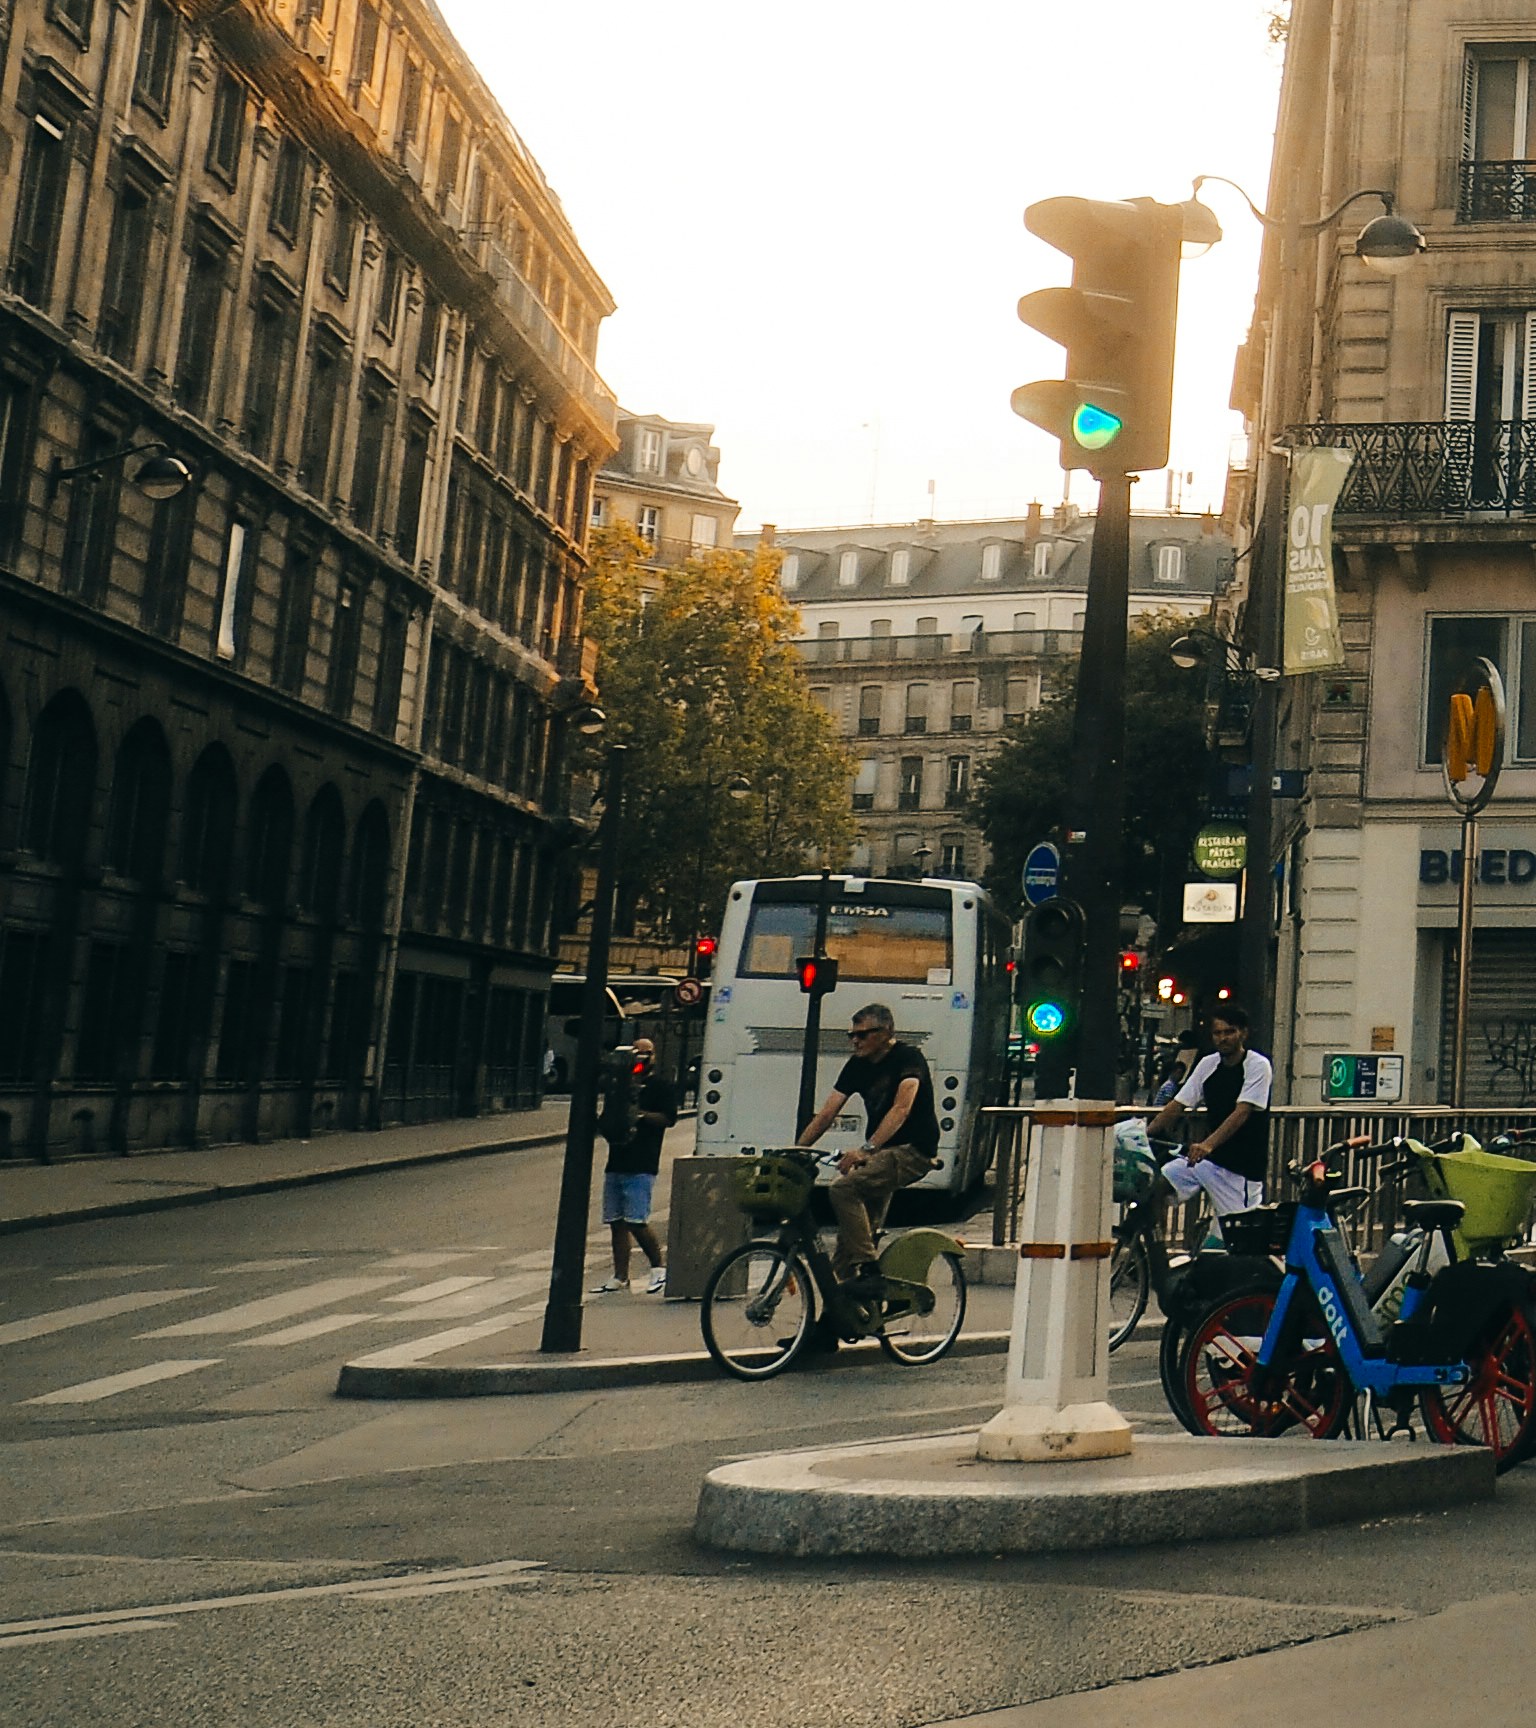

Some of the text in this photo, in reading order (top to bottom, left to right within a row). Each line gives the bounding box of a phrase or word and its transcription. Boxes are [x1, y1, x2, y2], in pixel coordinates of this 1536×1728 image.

[1197, 836, 1247, 847] RESTAURANT
[1208, 846, 1236, 857] PÂTES
[1201, 857, 1243, 869] FRAÎCHES
[830, 904, 889, 917] EMSA
[1318, 1286, 1348, 1348] dott
